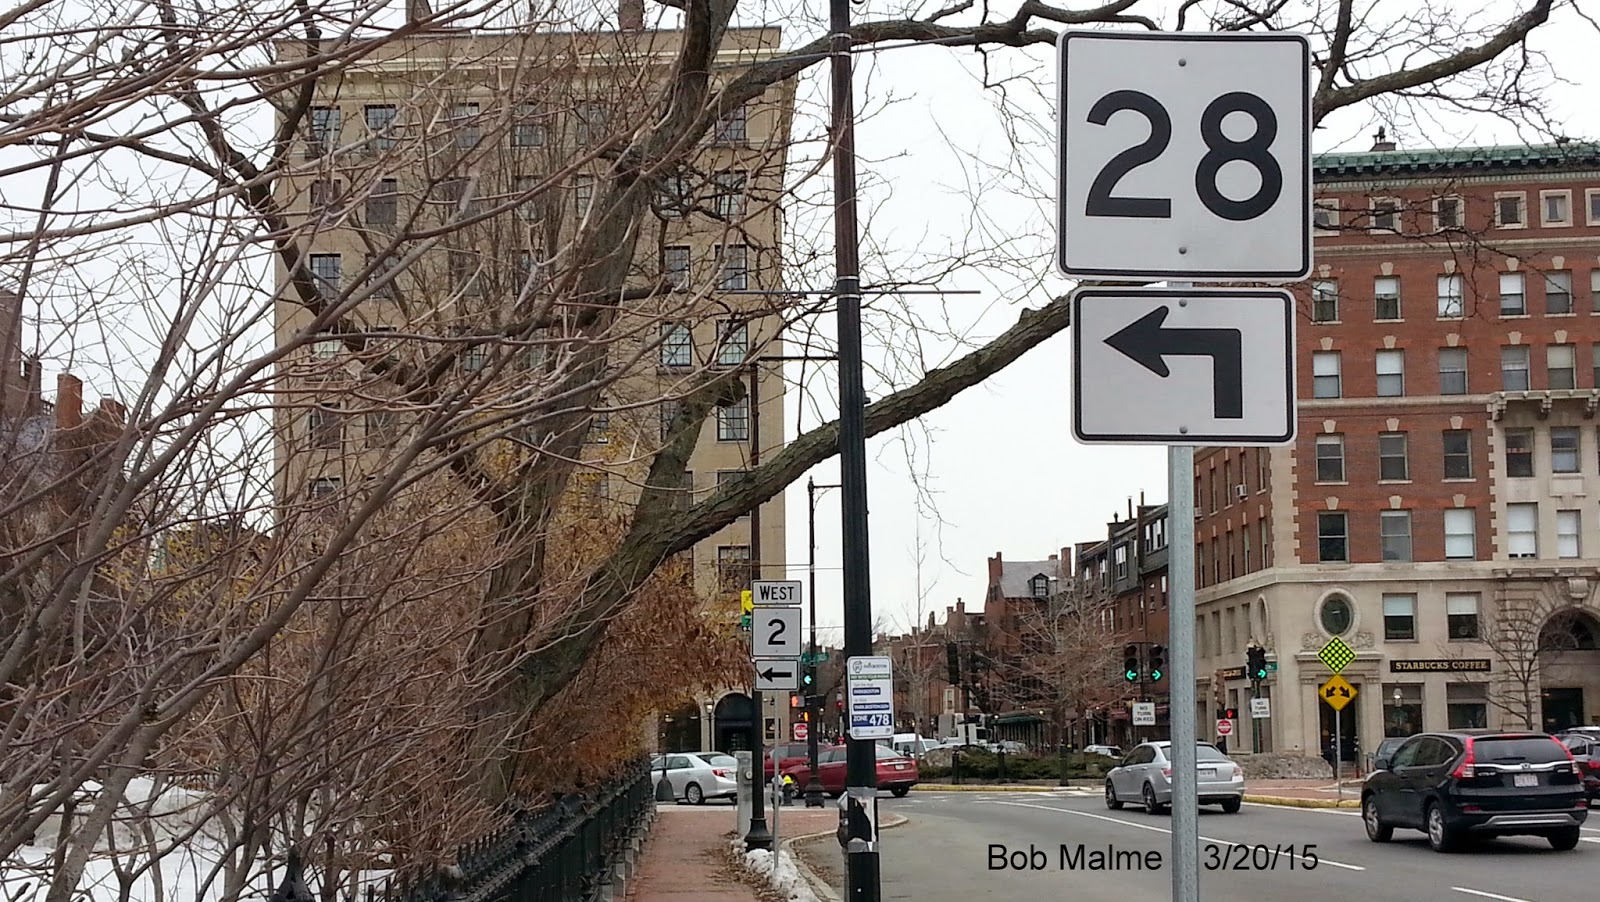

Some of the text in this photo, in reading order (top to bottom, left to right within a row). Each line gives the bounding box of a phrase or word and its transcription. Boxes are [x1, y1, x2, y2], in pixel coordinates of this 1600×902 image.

[1085, 89, 1283, 221] 28
[759, 585, 794, 600] WEST
[767, 618, 786, 645] 2
[1395, 661, 1488, 670] STARBUCKS COFFEE
[869, 714, 890, 726] 478
